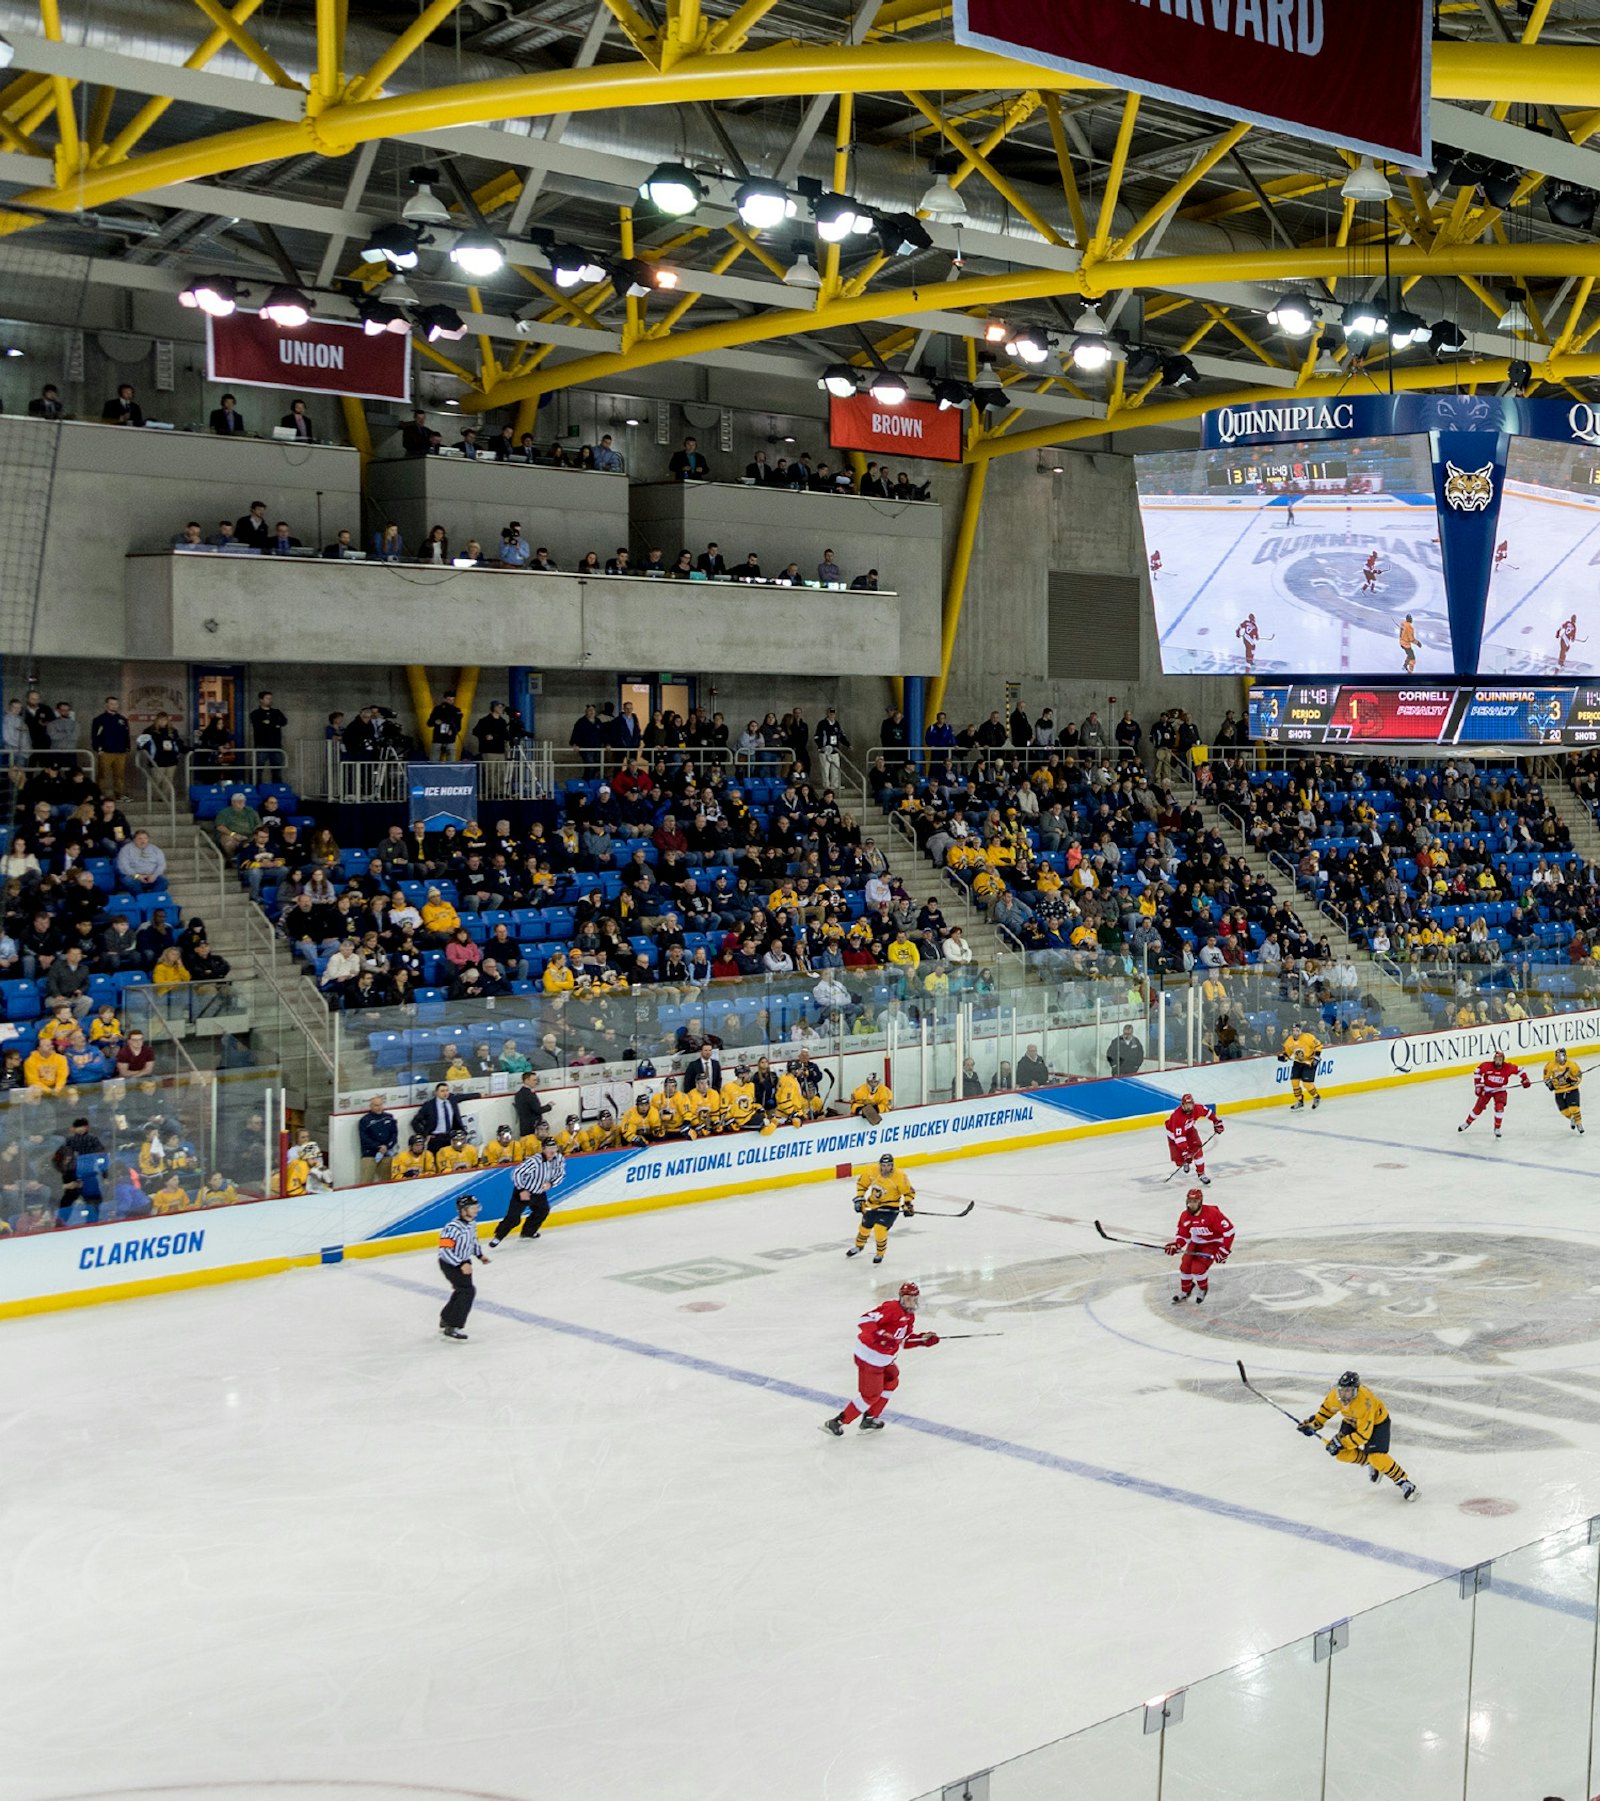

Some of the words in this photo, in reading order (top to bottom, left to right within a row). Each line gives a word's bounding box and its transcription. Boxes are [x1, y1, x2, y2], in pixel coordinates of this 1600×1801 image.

[279, 339, 344, 370] UNION
[872, 413, 922, 438] BROWN
[1218, 404, 1353, 443] QUINNIPIAC
[1233, 470, 1242, 484] 3
[1300, 689, 1327, 704] 11:48
[1398, 691, 1450, 702] CORNELL
[1475, 692, 1535, 702] QUINNIPIAC
[1271, 699, 1278, 718] 3
[1291, 709, 1321, 719] PERIOD
[1349, 700, 1358, 719] 1
[1397, 705, 1447, 716] PENALTY
[1470, 705, 1519, 717] PENALTY
[1550, 701, 1561, 720] 3
[1288, 729, 1312, 739] SHOTS
[1335, 729, 1342, 739] 7
[1550, 730, 1561, 740] 20
[1574, 731, 1597, 741] SHOTS
[424, 787, 440, 796] ICE
[440, 786, 473, 796] HOCKEY
[1390, 1029, 1511, 1074] QUINNIPIAC
[626, 1162, 662, 1183] 2016
[665, 1152, 733, 1177] NATIONAL
[737, 1140, 813, 1165] COLLEGIATE
[817, 1130, 877, 1153] WOMEN'S
[880, 1126, 899, 1143] ICE
[903, 1119, 950, 1141] HOCKEY
[952, 1106, 1034, 1132] QUARTERFINAL
[79, 1229, 205, 1270] CLARKSON
